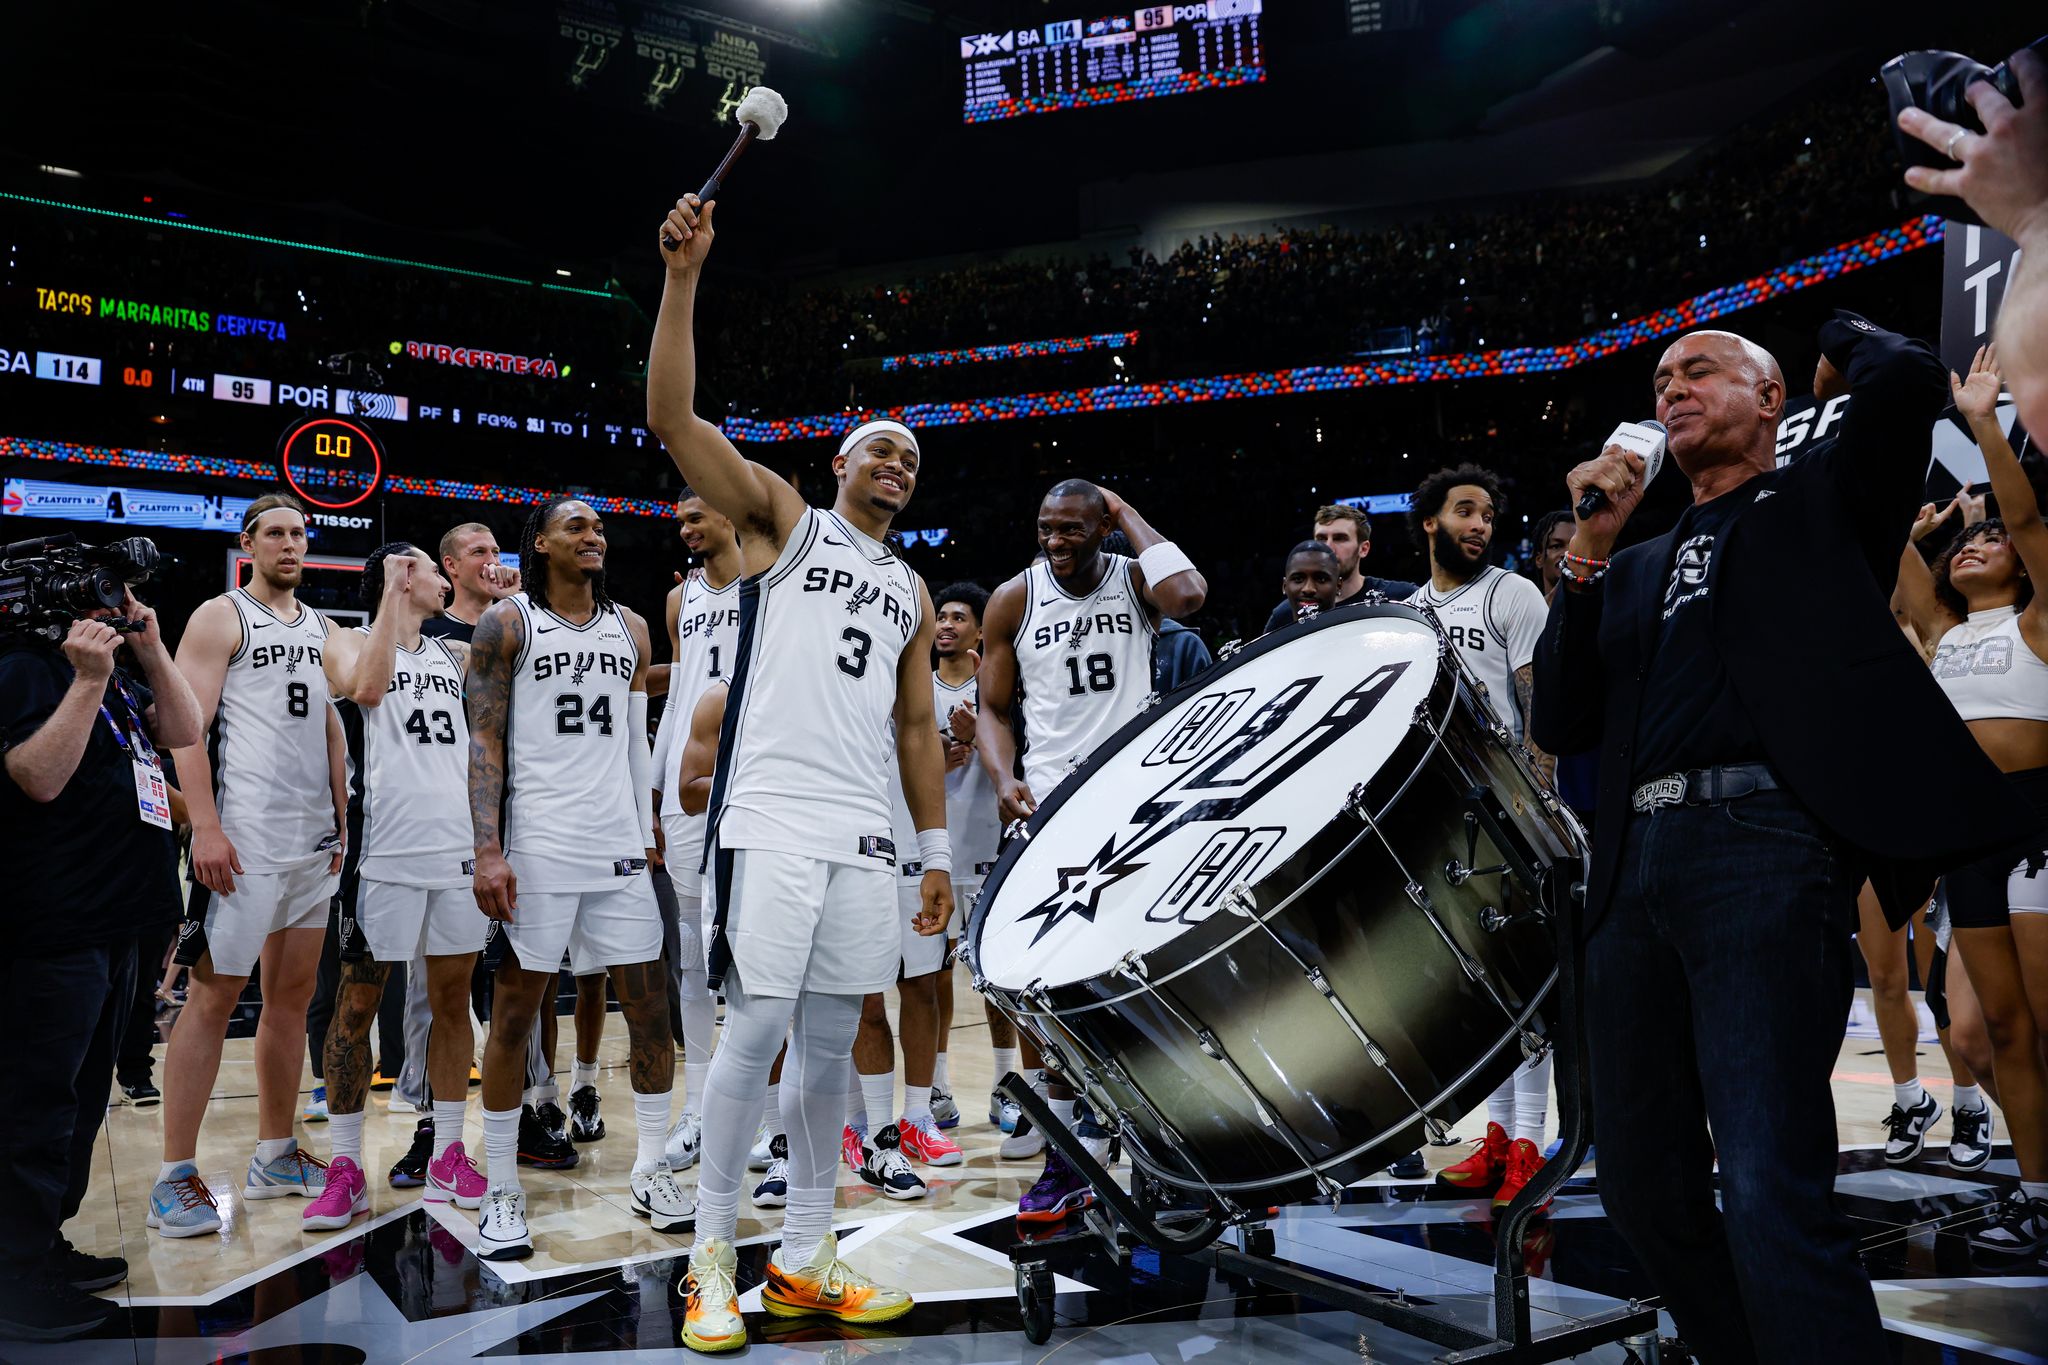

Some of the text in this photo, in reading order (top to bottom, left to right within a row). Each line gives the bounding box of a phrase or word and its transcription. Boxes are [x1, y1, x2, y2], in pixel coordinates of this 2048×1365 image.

[1144, 11, 1165, 28] 95
[1173, 4, 1207, 21] POR
[560, 24, 620, 49] 2007
[721, 32, 759, 53] NBA
[1017, 29, 1040, 47] SA
[1053, 23, 1075, 39] 114
[637, 43, 697, 69] 2013
[707, 61, 761, 87] 2014
[37, 287, 92, 316] TACOS
[100, 297, 210, 333] MARGARITAS
[215, 313, 287, 341] CERVEZA
[406, 340, 558, 379] BURGERTECA
[0, 348, 328, 410] SA 114 0.0 4TH 95 POR
[420, 404, 442, 420] PF
[477, 412, 518, 429] FG%
[550, 421, 573, 436] TO
[582, 423, 588, 439] 1
[315, 433, 351, 458] 0.0
[38, 495, 82, 505] PLAYOFFS
[139, 503, 180, 513] PLAYOFFS
[312, 513, 373, 529] TISSOT
[803, 567, 912, 642] SPURS
[1100, 594, 1121, 602] LEDGER
[1453, 605, 1474, 613] LEDGER
[683, 609, 739, 639] SPUR
[1034, 612, 1133, 650] SPURS
[252, 643, 323, 675] SPUR
[709, 644, 722, 680] 1
[835, 624, 872, 681] 3
[533, 651, 633, 687] SPURS
[1065, 651, 1118, 698] 18
[287, 680, 309, 719] 8
[554, 691, 613, 738] 24
[403, 708, 456, 746] 43
[1141, 687, 1256, 767] GO
[1637, 781, 1681, 809] SPURS
